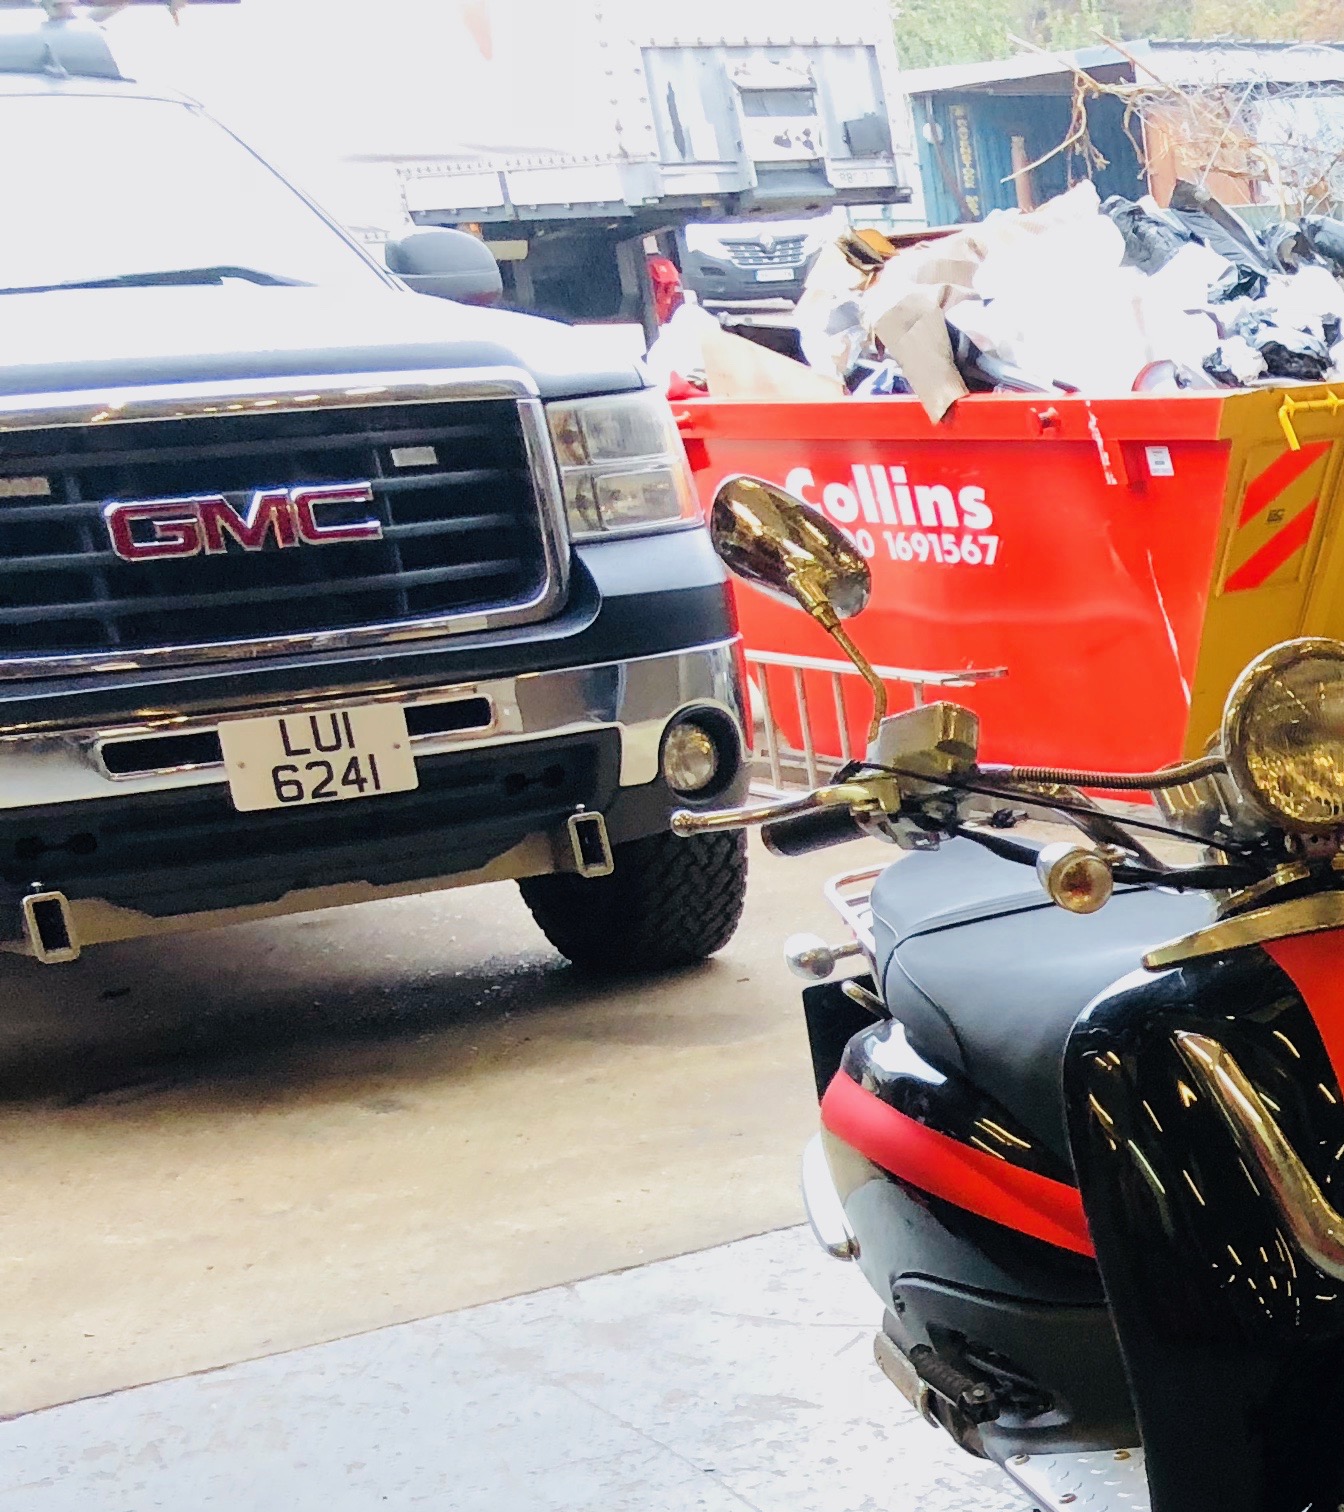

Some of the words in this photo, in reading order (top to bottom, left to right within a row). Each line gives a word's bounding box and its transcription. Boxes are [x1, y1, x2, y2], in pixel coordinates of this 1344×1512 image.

[104, 481, 384, 562] GMC
[785, 463, 994, 530] Collins
[882, 530, 999, 565] 1691567
[278, 711, 356, 758] LUI
[271, 753, 382, 804] 6241
